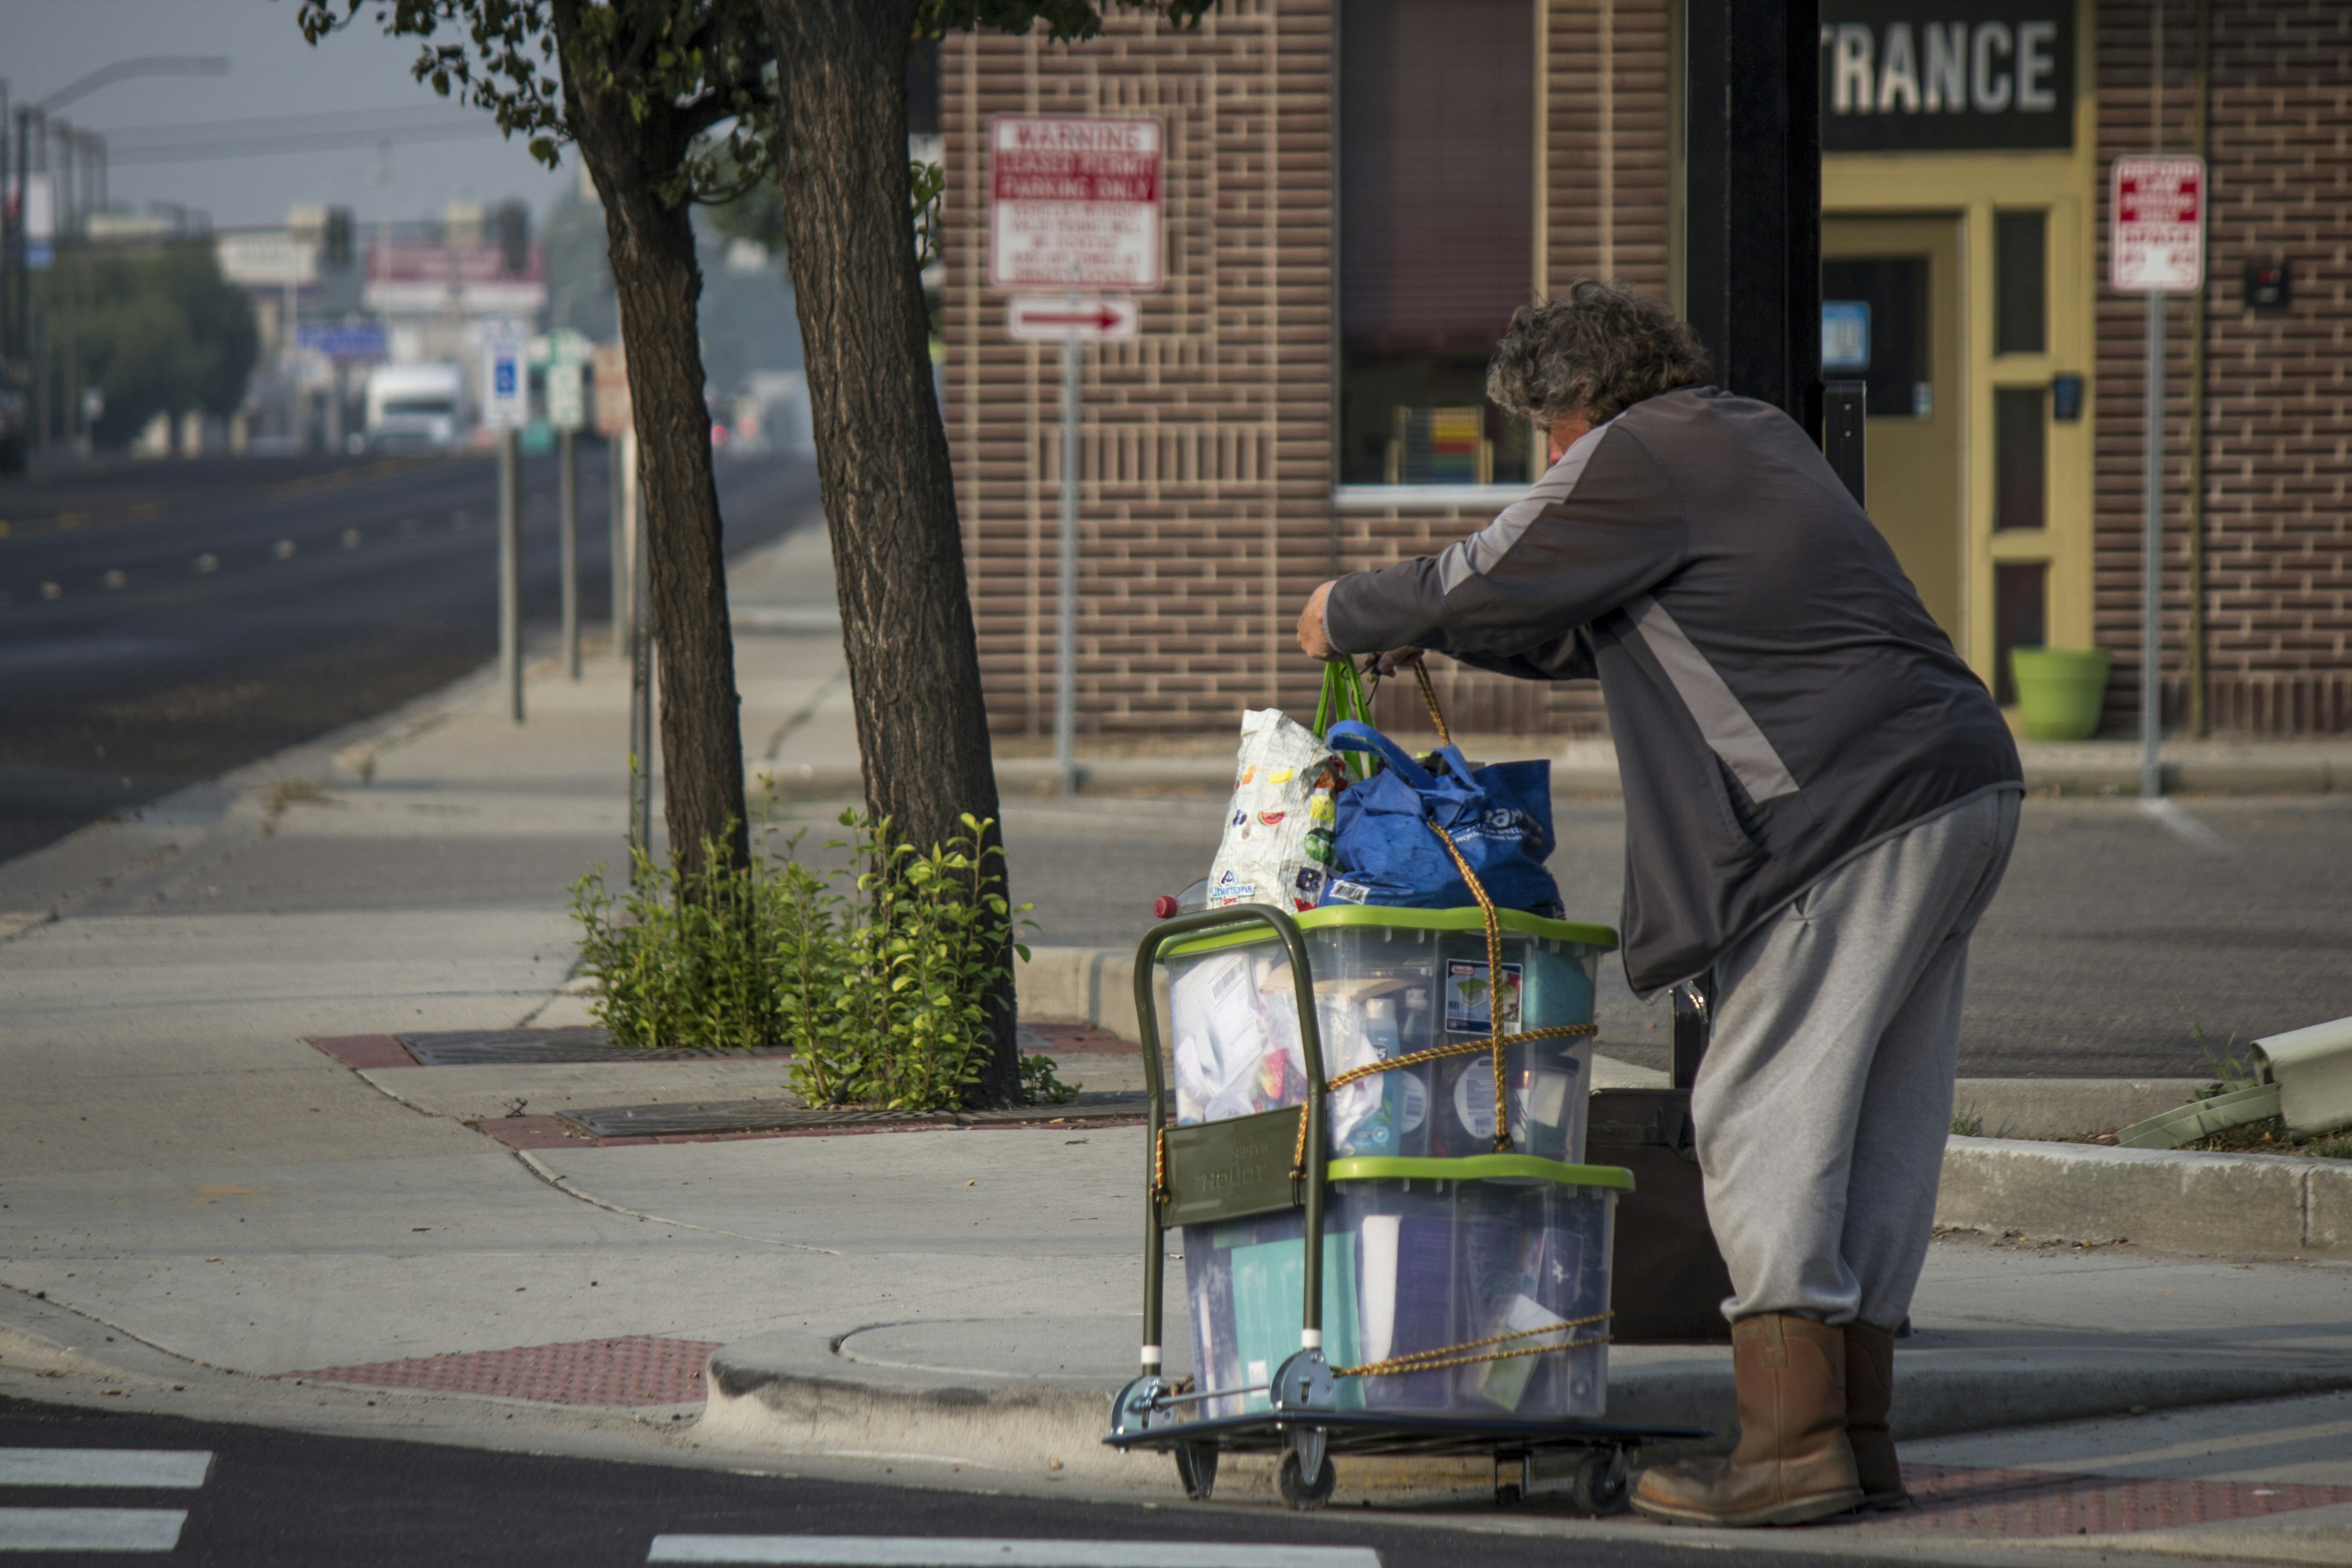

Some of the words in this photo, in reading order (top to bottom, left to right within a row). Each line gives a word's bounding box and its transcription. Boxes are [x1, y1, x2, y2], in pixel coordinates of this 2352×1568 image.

[1017, 124, 1142, 149] WARNING
[1003, 176, 1091, 198] PARKING
[1098, 177, 1151, 198] ONLY
